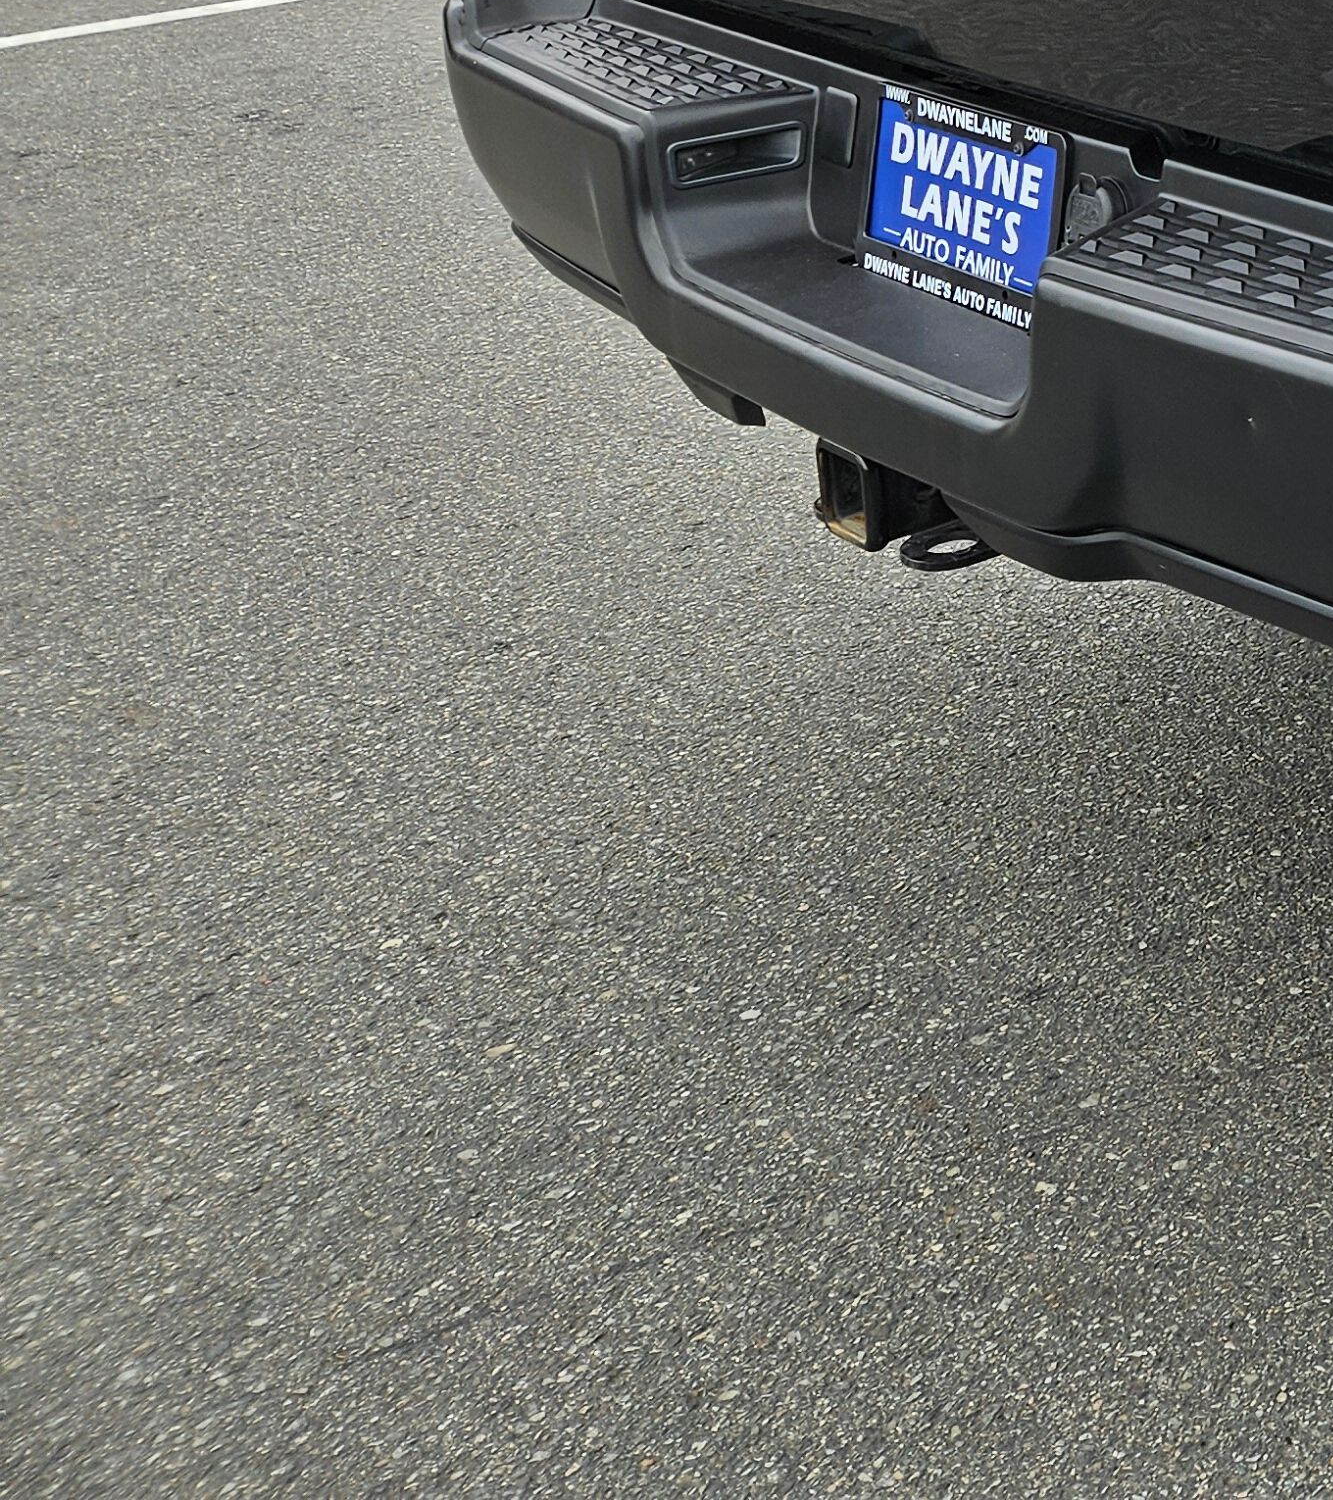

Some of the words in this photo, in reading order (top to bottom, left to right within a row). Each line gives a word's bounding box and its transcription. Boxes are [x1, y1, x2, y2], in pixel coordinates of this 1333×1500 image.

[917, 97, 1012, 143] DWAYNELANE
[1024, 125, 1049, 145] .COM
[890, 121, 1044, 210] DWAYNE
[900, 174, 1022, 256] LANE'S
[863, 252, 910, 284] DWAYNE
[911, 269, 952, 299] LANE'S
[952, 286, 985, 312] AUTO
[985, 299, 1033, 330] FAMILY
[899, 227, 950, 263] AUTO
[954, 243, 1015, 287] FAMILY
